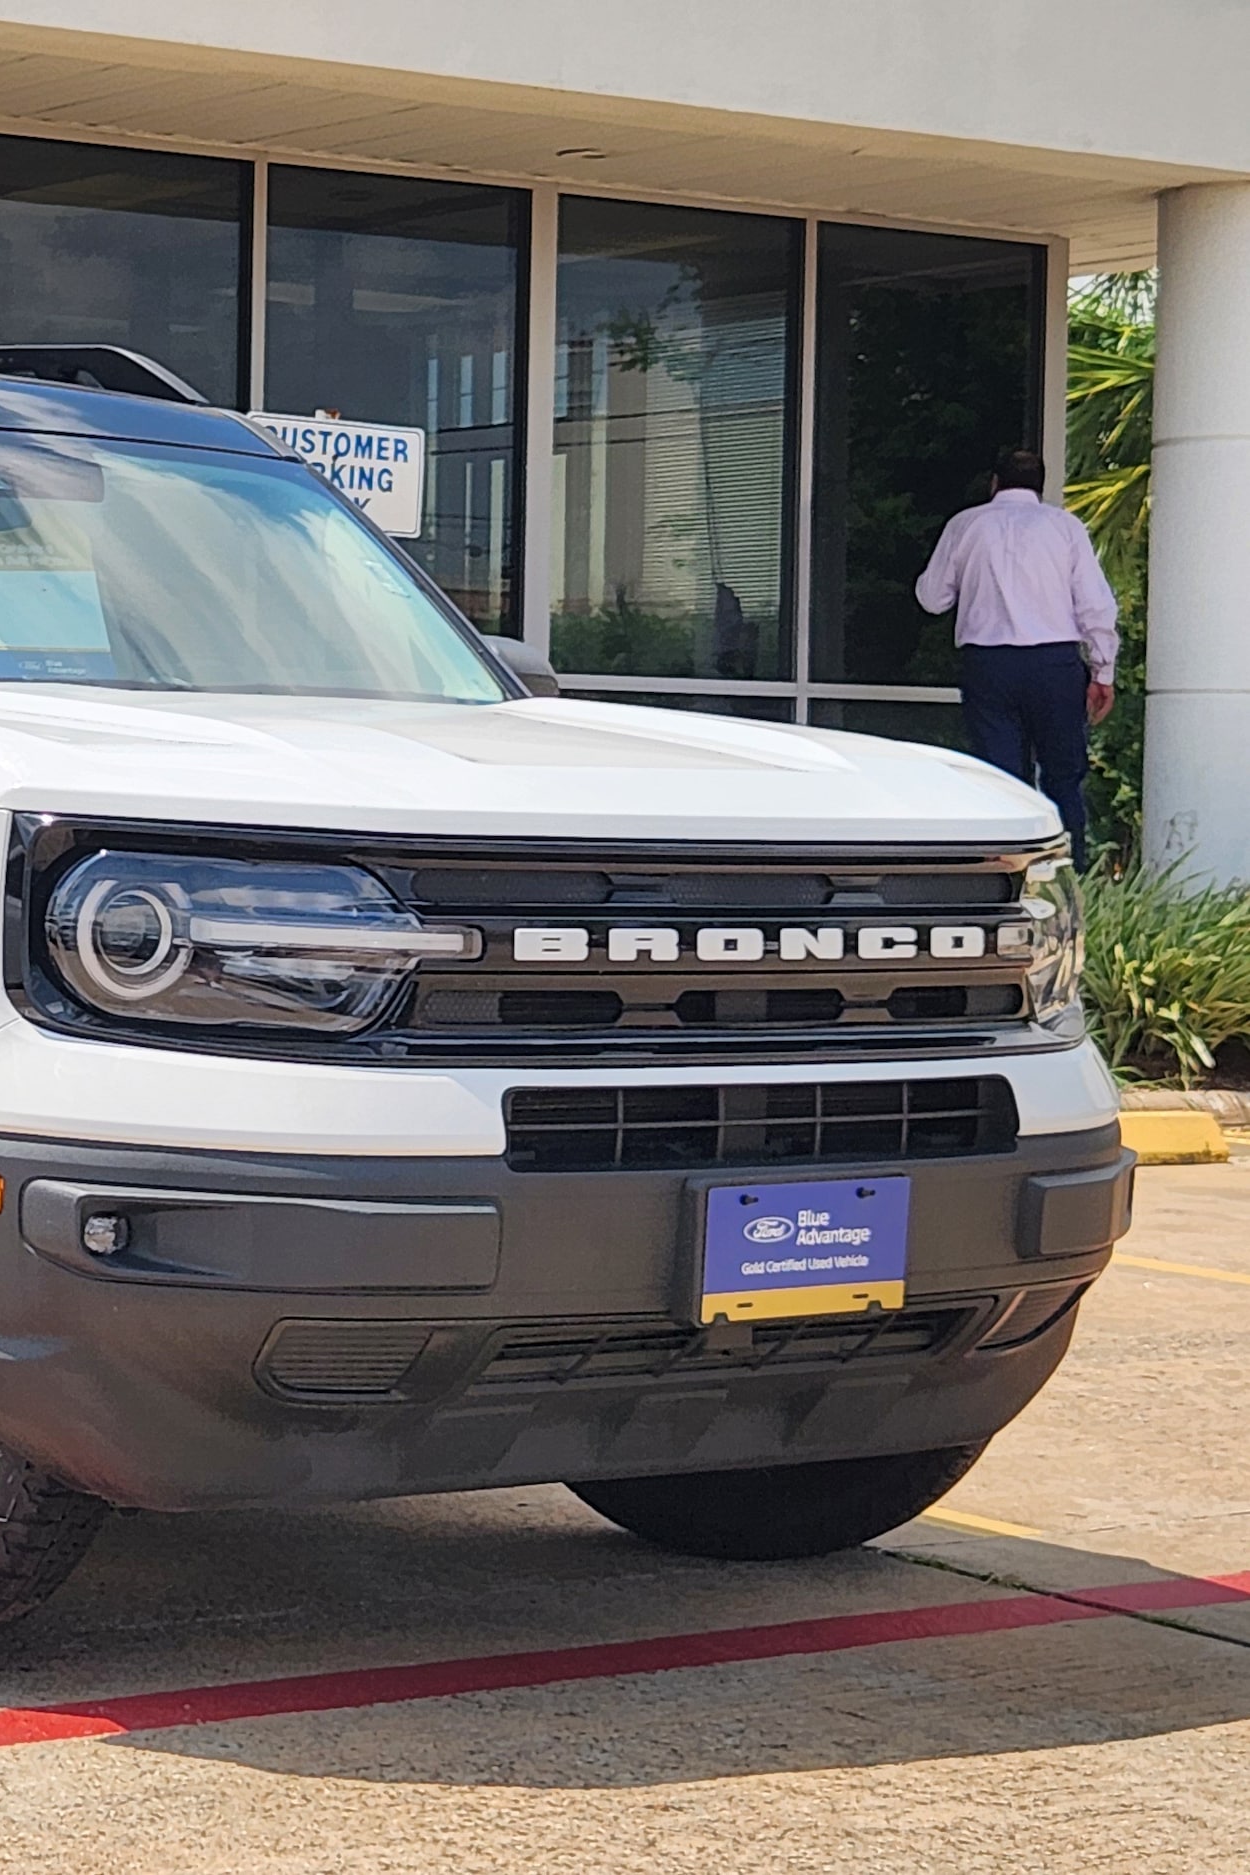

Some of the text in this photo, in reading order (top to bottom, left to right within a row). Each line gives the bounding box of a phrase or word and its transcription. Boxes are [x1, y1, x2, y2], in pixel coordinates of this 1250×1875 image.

[513, 926, 986, 961] BRONCO
[797, 1209, 830, 1227] Blue
[753, 1220, 787, 1239] Ford
[796, 1227, 872, 1247] Advantage
[741, 1260, 765, 1276] Gold
[807, 1256, 834, 1271] Used
